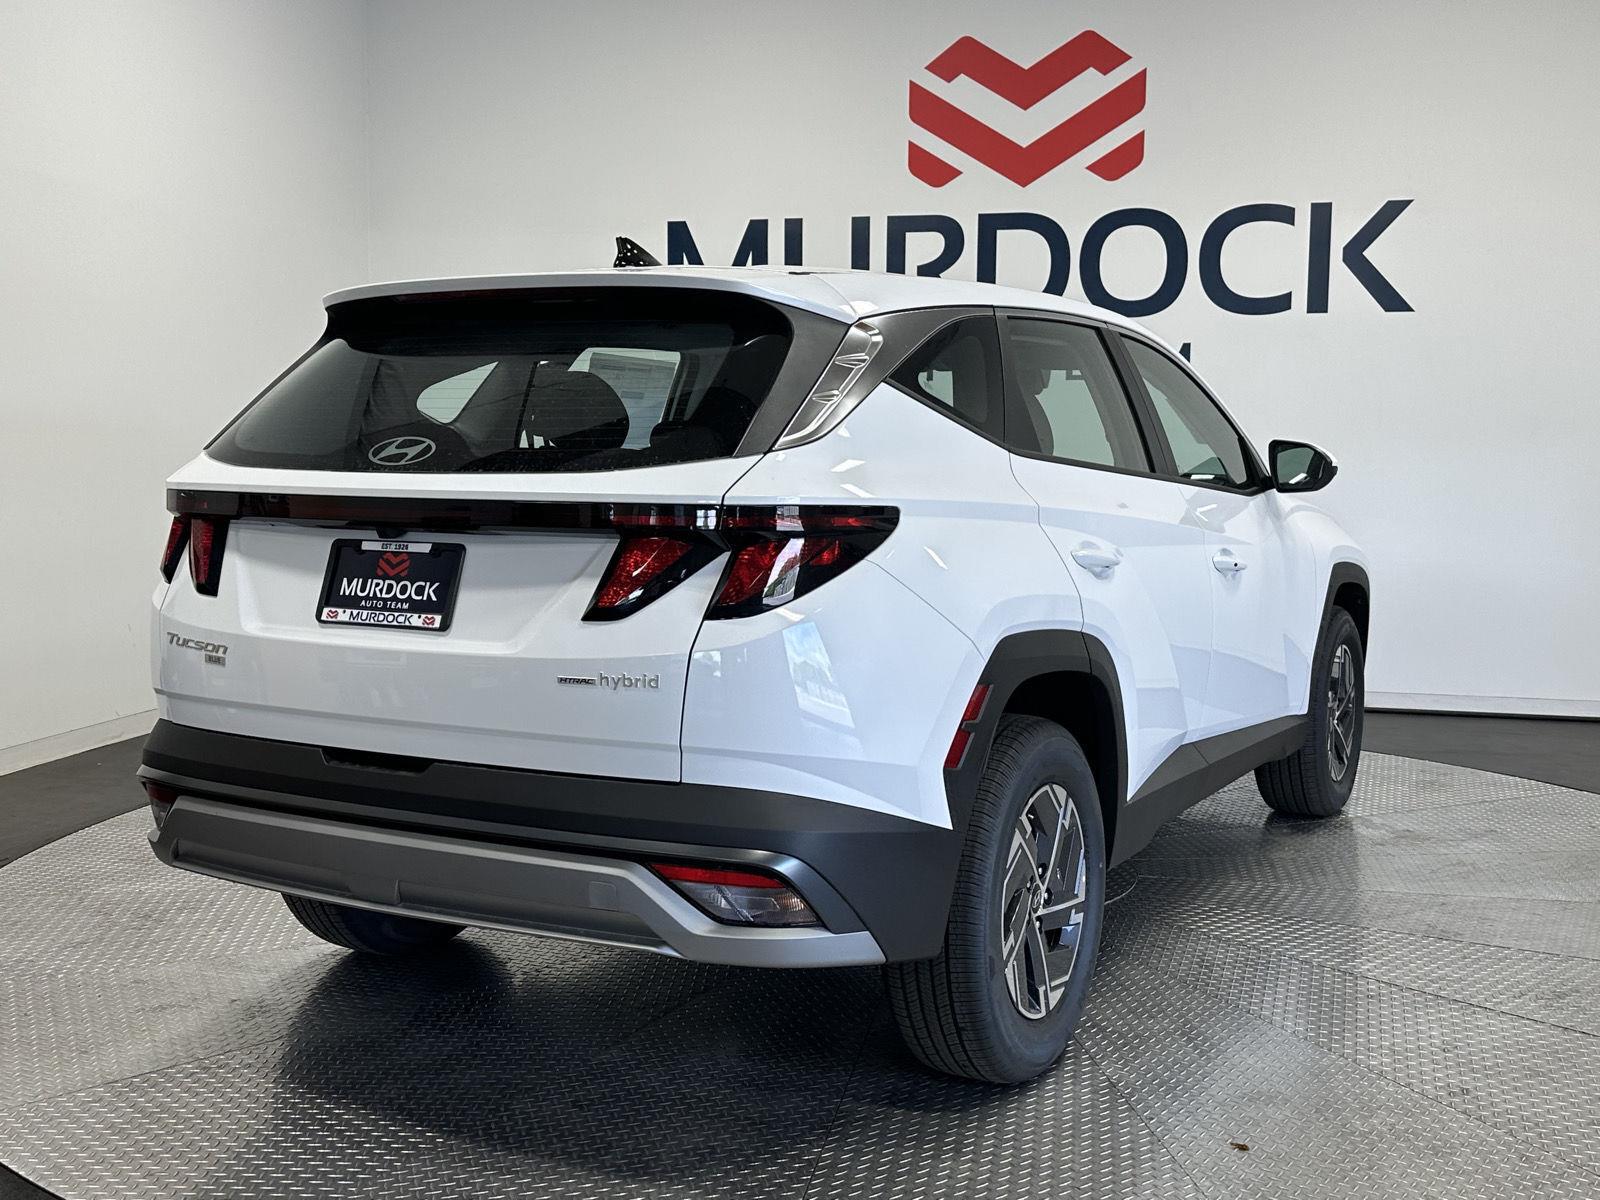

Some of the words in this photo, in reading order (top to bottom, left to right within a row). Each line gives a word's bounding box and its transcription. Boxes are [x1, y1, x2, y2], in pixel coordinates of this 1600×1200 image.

[339, 577, 440, 601] MURDOCK
[360, 600, 383, 608] AUTO
[387, 601, 409, 609] TEAM
[348, 610, 414, 625] MURDOCK
[600, 671, 660, 691] hybrid
